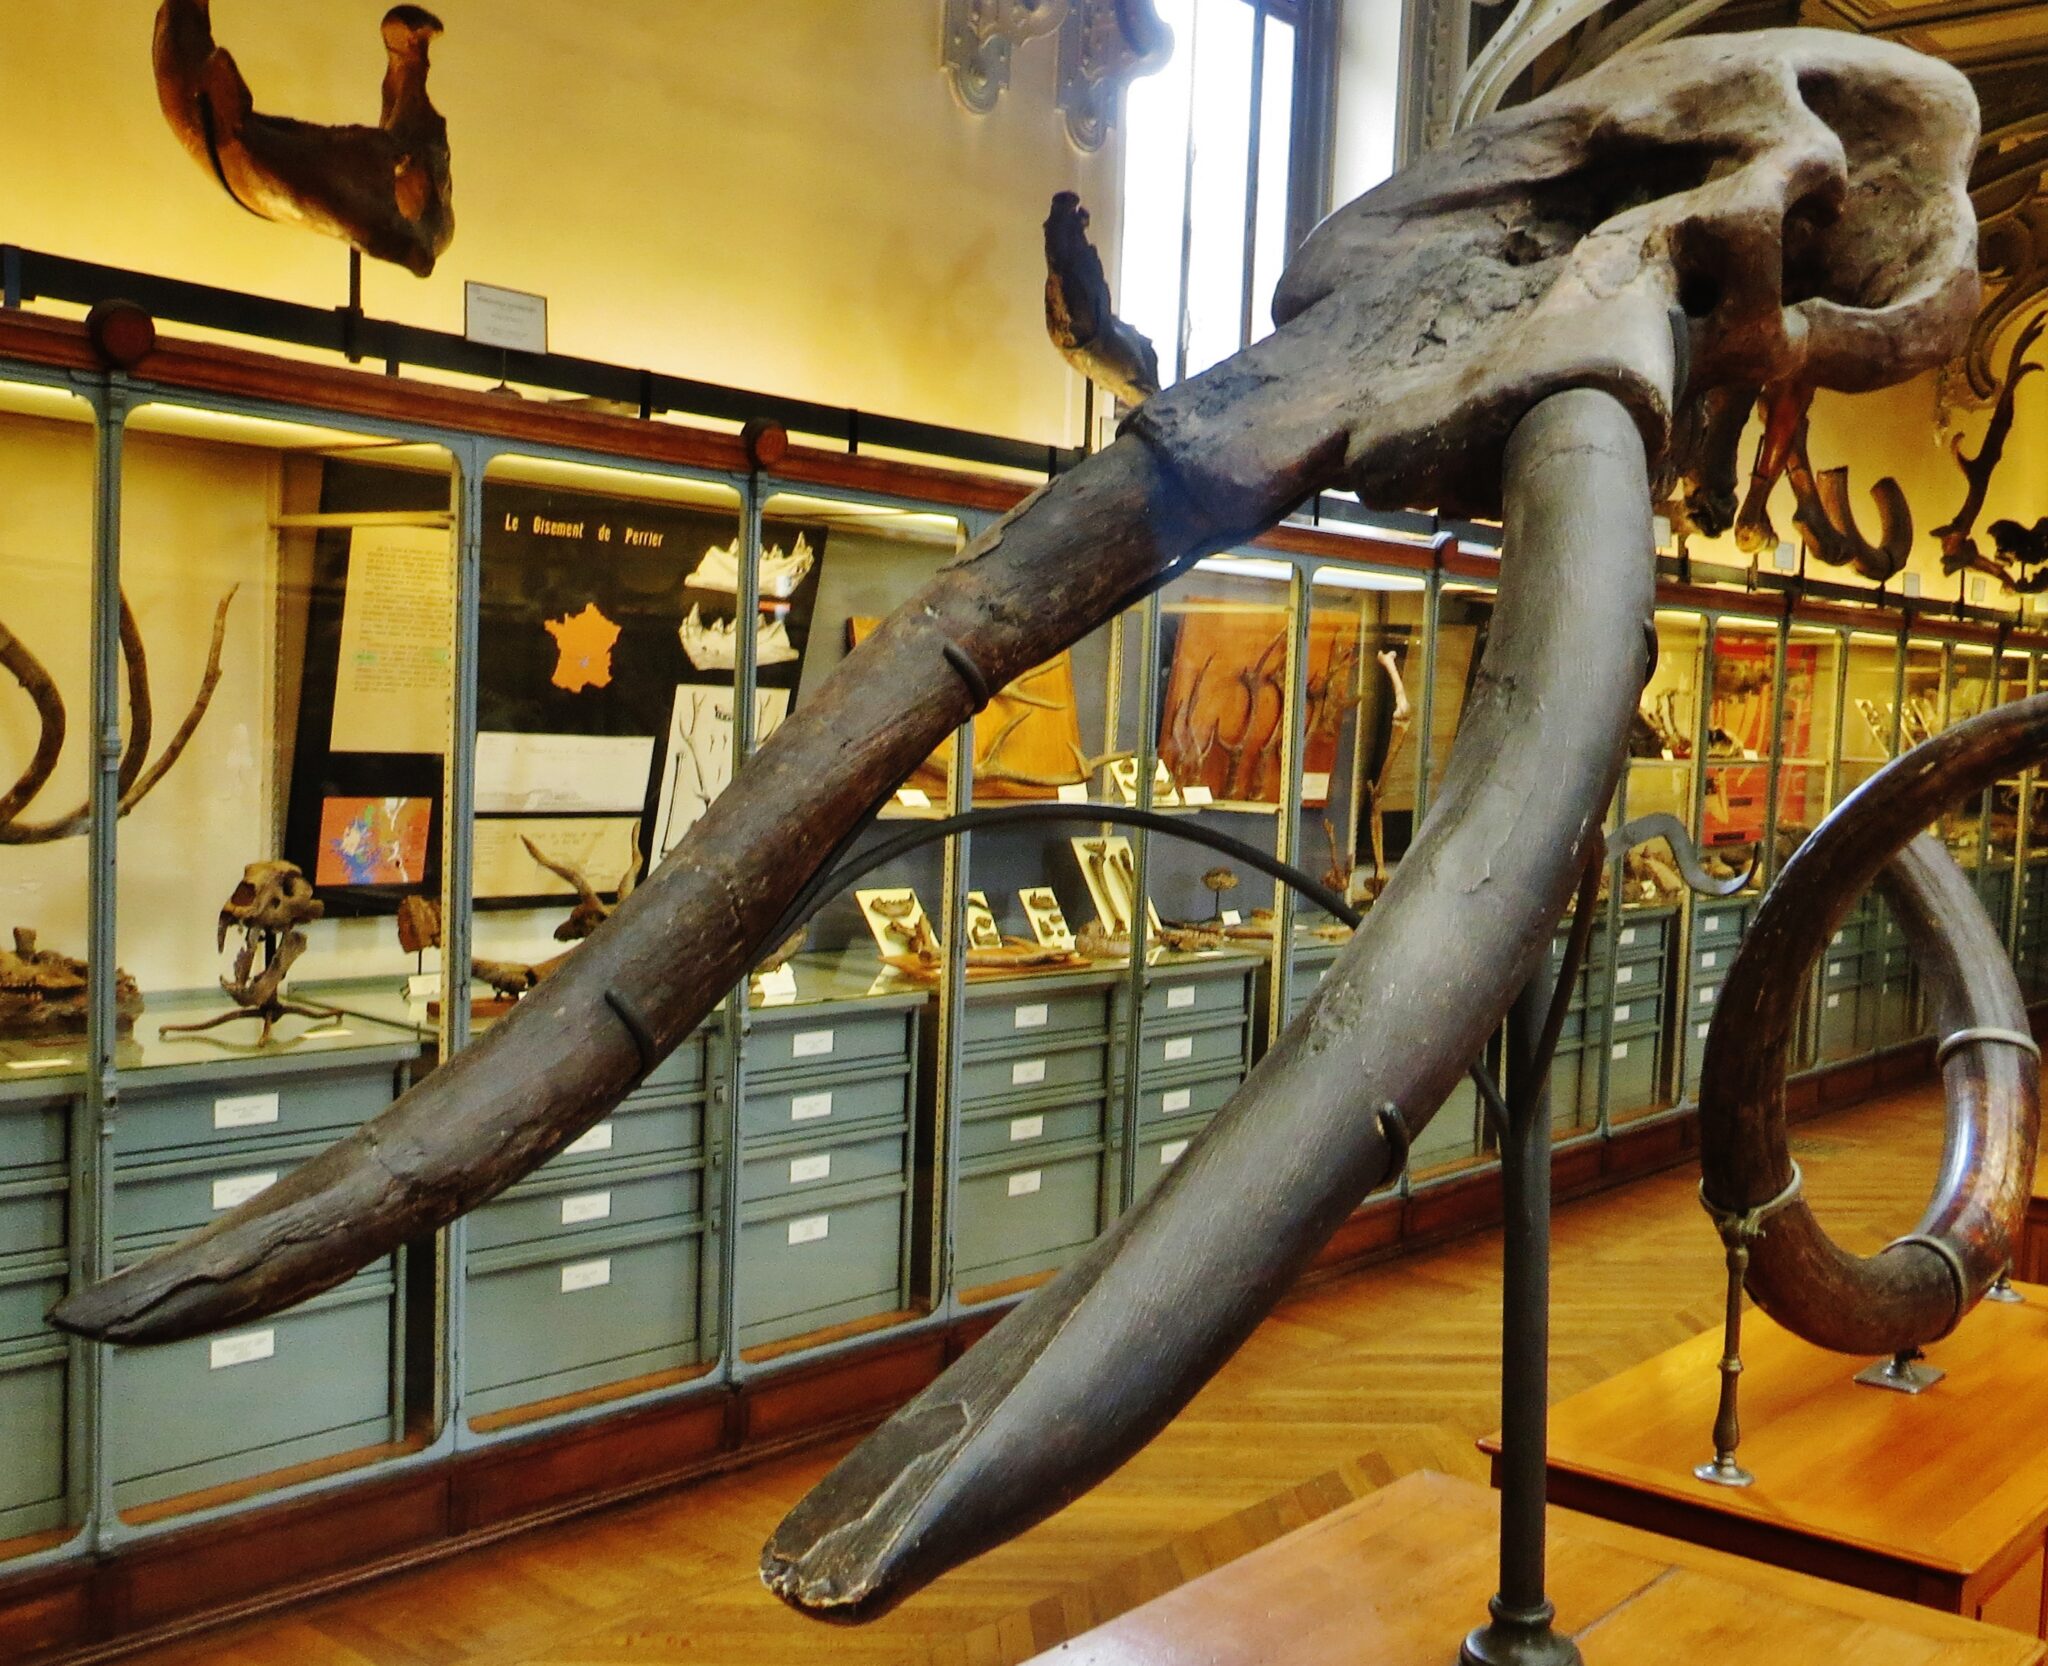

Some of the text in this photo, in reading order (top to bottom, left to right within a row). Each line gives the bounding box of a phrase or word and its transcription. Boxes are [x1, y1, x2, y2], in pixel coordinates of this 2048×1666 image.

[504, 513, 664, 547] Le Gisement de Perrier
